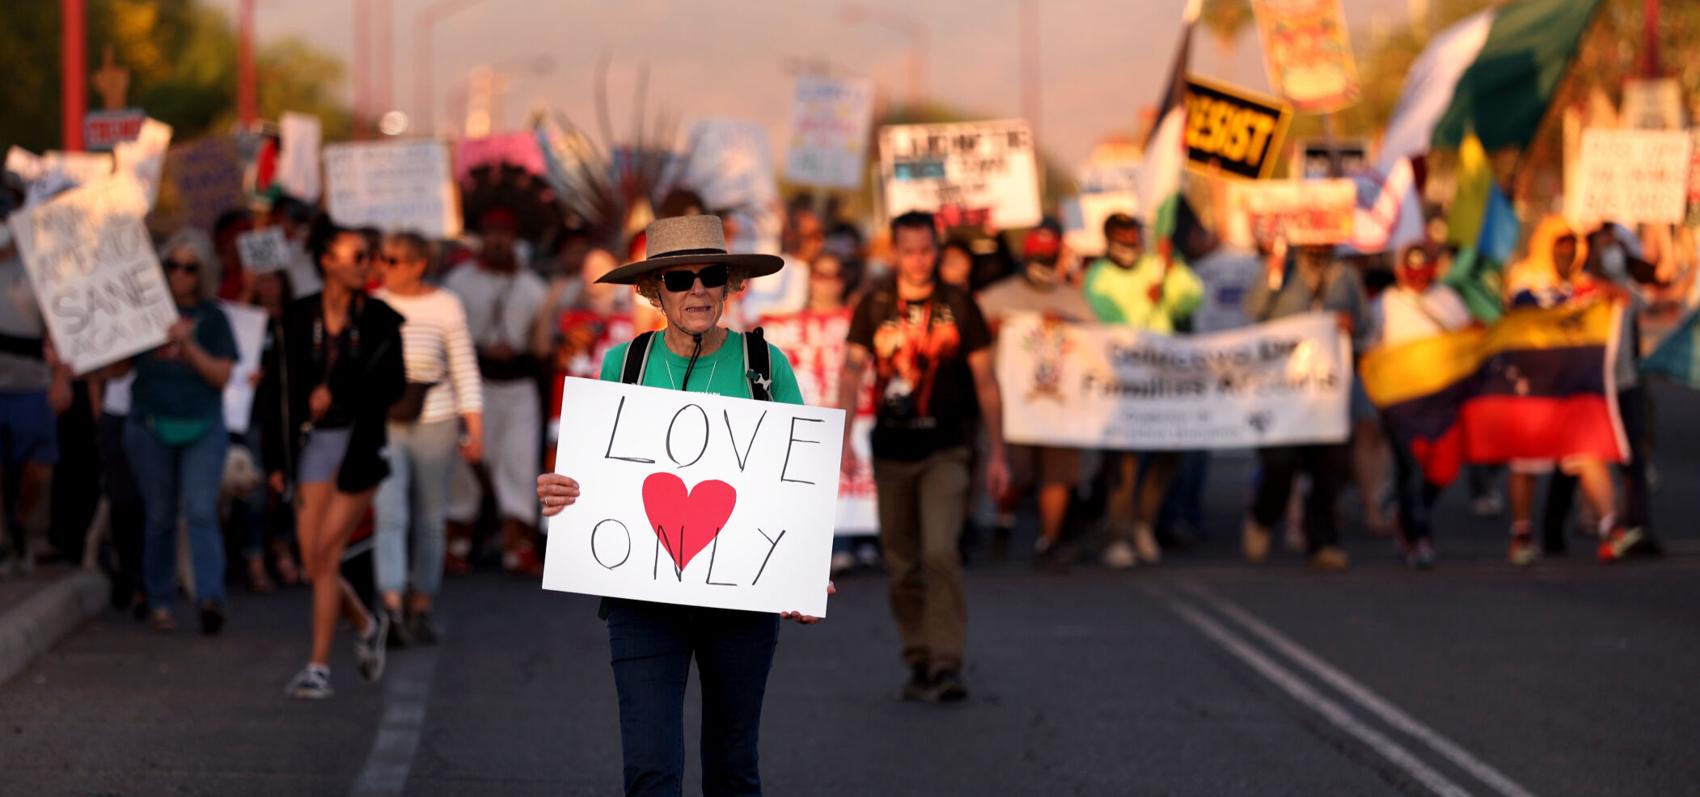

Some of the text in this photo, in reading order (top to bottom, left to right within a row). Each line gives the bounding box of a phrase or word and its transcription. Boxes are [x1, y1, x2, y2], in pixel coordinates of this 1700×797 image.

[51, 257, 162, 337] SANE
[603, 395, 826, 486] LOVE
[590, 518, 787, 587] ONLY
